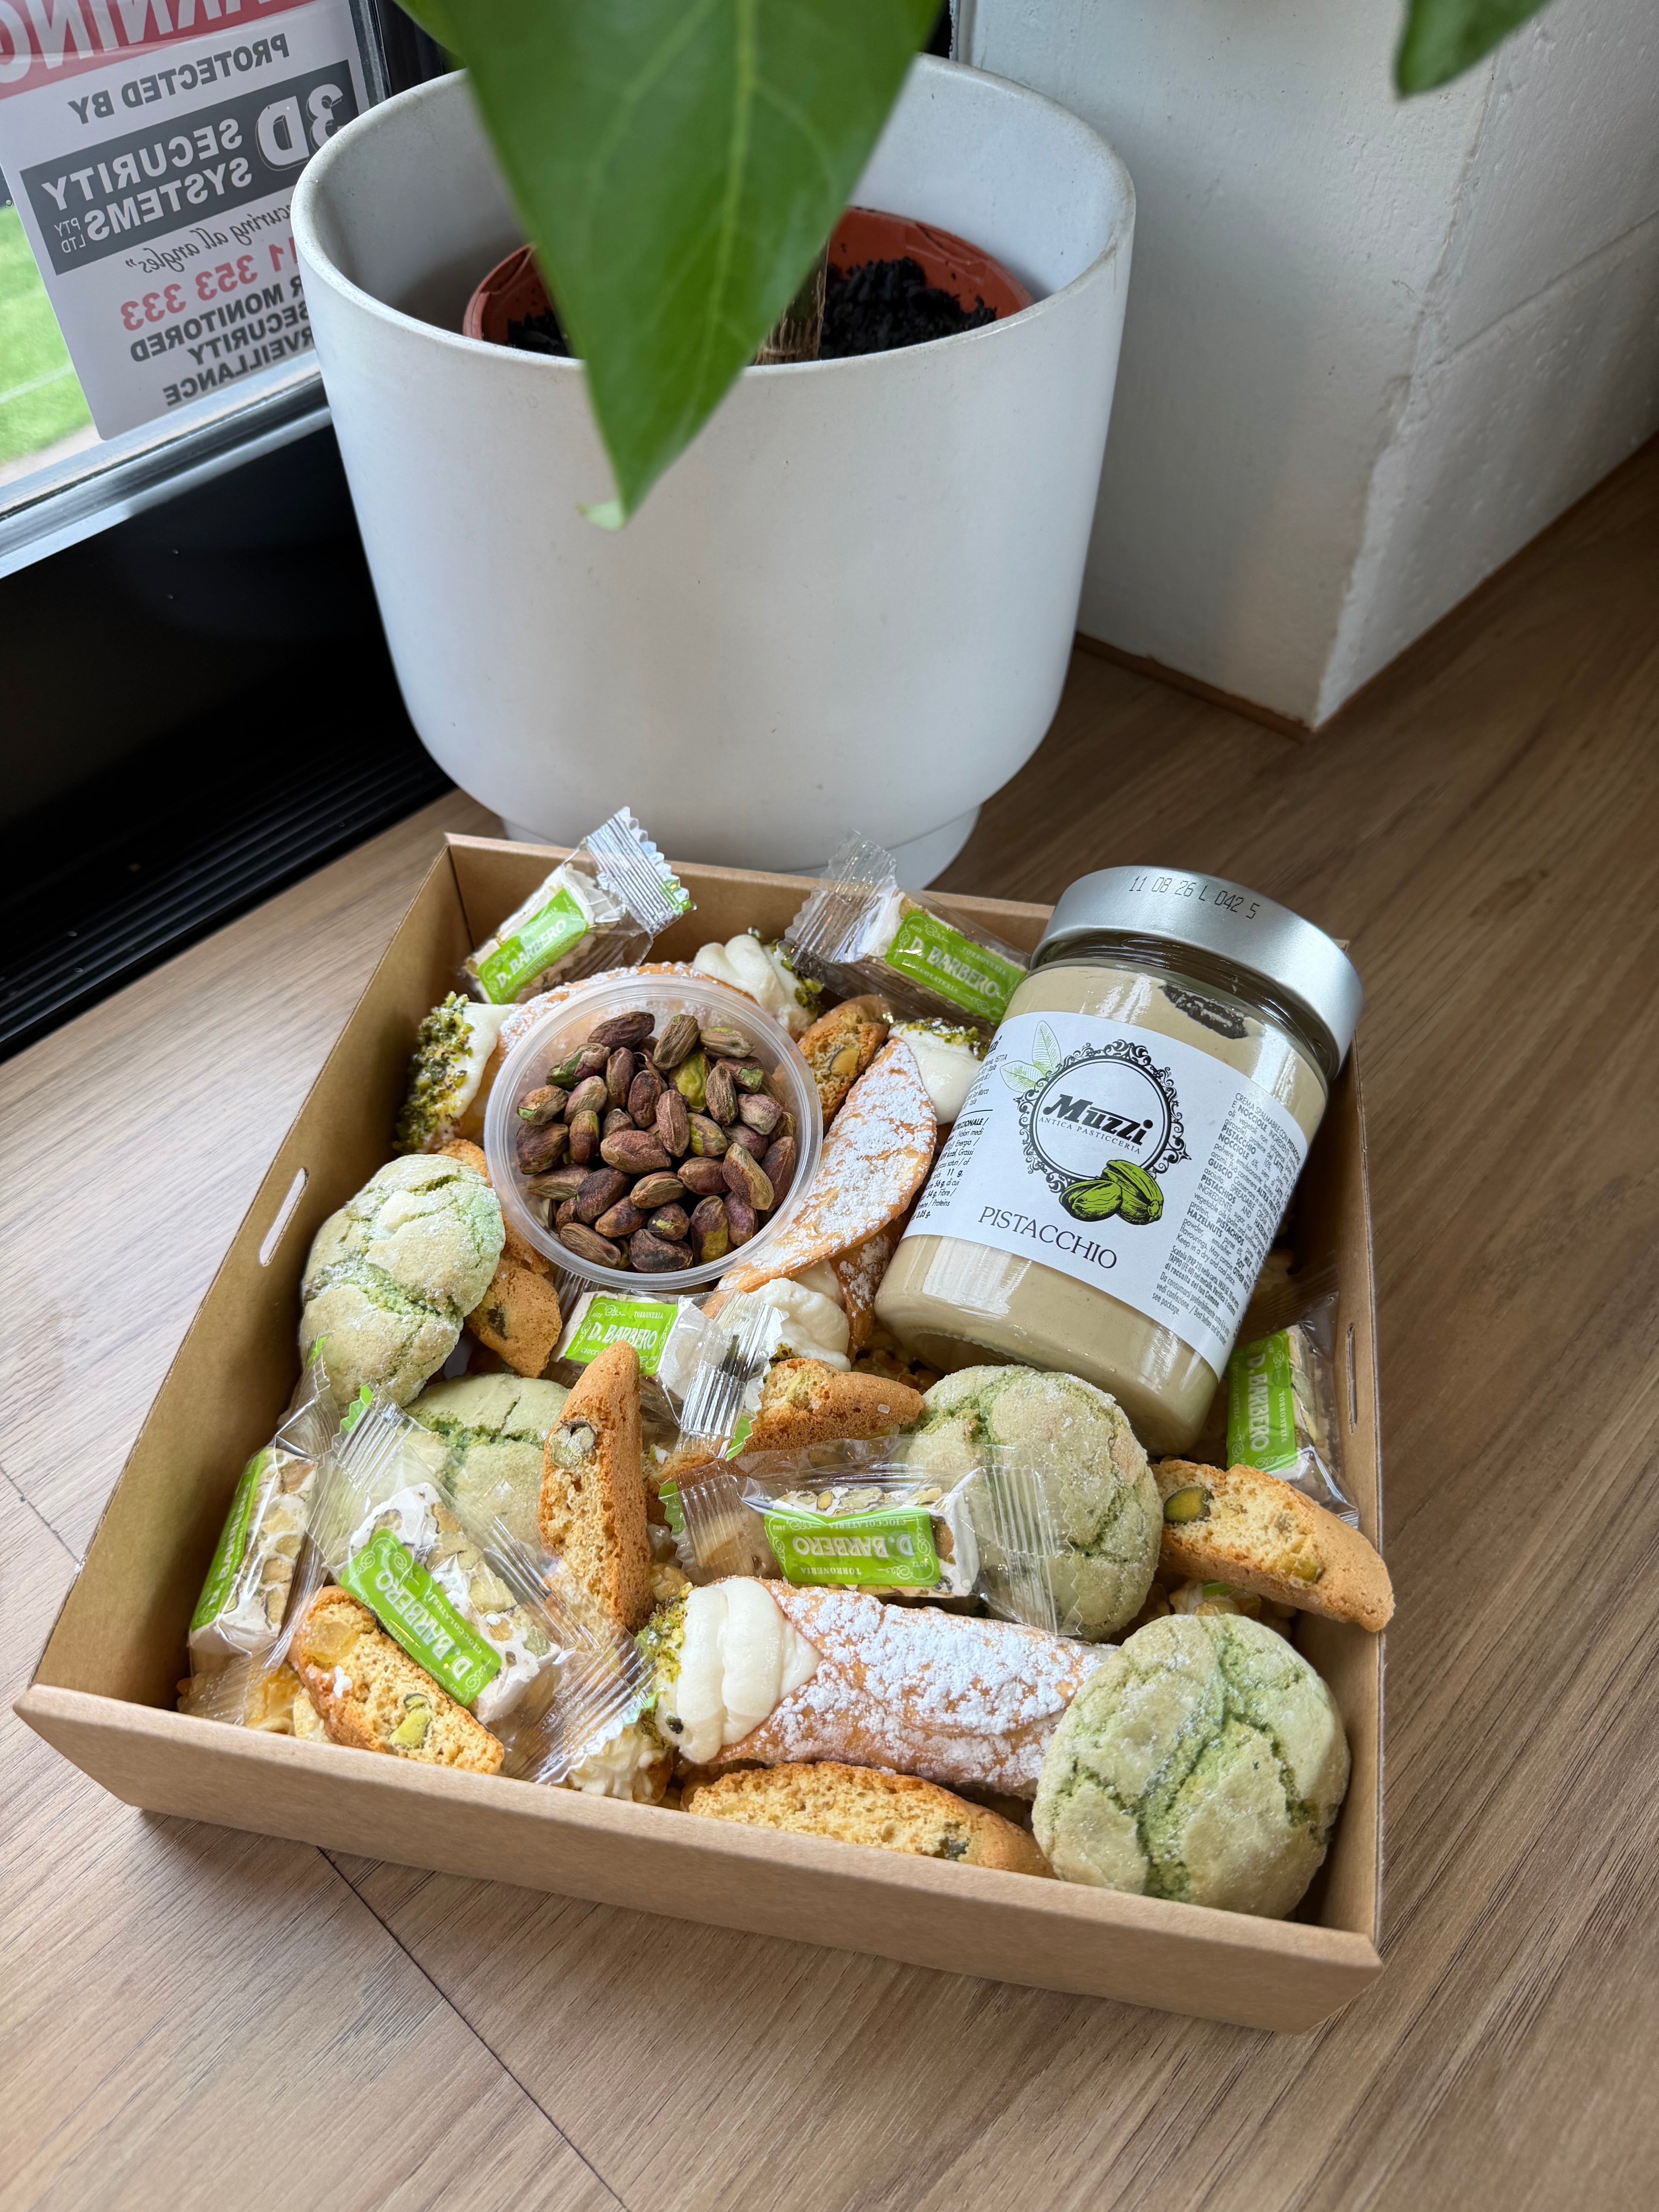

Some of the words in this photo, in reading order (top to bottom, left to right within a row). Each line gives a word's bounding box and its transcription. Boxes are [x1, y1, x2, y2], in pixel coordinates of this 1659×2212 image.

[1128, 876, 1147, 891] 11
[1152, 877, 1172, 893] 08
[1174, 880, 1196, 897] 26
[1198, 885, 1208, 901] L
[1214, 891, 1244, 912] 042
[1246, 903, 1260, 919] 5
[509, 919, 567, 975] BARBERO
[961, 946, 1006, 976] TORRONERIA
[926, 945, 999, 998] BARBERO
[1042, 1094, 1153, 1146] Muzzi
[1231, 1100, 1237, 1108] E
[1234, 1092, 1256, 1111] CREMA
[1254, 1106, 1281, 1133] SPALMABILE
[1278, 1128, 1288, 1143] CON
[970, 1127, 984, 1135] medi
[1038, 1116, 1072, 1130] ANTICA
[1077, 1125, 1140, 1154] PASTICCERIA
[1221, 1124, 1257, 1156] PISTACCHIO
[1228, 1107, 1237, 1118] oli
[1238, 1115, 1258, 1136] vegetali
[1259, 1133, 1268, 1144] non
[1213, 1140, 1236, 1162] polvere,
[1218, 1132, 1250, 1160] NOCCIOLE
[1248, 1134, 1267, 1156] proteine
[938, 1188, 952, 1196] Fibre
[945, 1177, 953, 1185] di
[1210, 1149, 1229, 1166] aromi.
[1228, 1161, 1239, 1173] Può
[1237, 1169, 1258, 1191] contenere
[1256, 1185, 1269, 1204] ALTRA
[1197, 1182, 1233, 1213] INGREDIENTS:
[1233, 1211, 1246, 1228] sugar,
[1200, 1173, 1237, 1204] PISTACHIOS
[1240, 1204, 1252, 1219] AND
[1229, 1183, 1255, 1211] SPREADABLE
[1186, 1207, 1223, 1238] HAZELNUTS
[1223, 1236, 1235, 1252] puree
[1189, 1199, 1211, 1219] protein,
[1215, 1216, 1244, 1247] PISTACHIOS
[1192, 1190, 1220, 1215] vegetable
[1218, 1206, 1228, 1219] oils
[1225, 1213, 1239, 1232] (palm
[1237, 1223, 1246, 1237] and
[978, 1206, 1117, 1269] PISTACCHIO
[1175, 1233, 1191, 1250] Keep
[1190, 1242, 1197, 1252] in
[1199, 1249, 1211, 1264] dry
[1209, 1255, 1219, 1269] and
[1218, 1262, 1228, 1276] cool
[1178, 1223, 1211, 1252] flavourings.
[1208, 1244, 1221, 1261] May
[1219, 1253, 1234, 1271] contain
[1182, 1215, 1206, 1237] powder,
[1235, 1257, 1245, 1272] SOY
[1164, 1261, 1171, 1271] di
[1170, 1265, 1192, 1285] raccolta
[1190, 1279, 1199, 1290] del
[1197, 1285, 1206, 1295] tuo
[1167, 1253, 1183, 1267] TAPPO
[1180, 1261, 1189, 1273] (FE
[1186, 1265, 1195, 1277] 40)
[1171, 1245, 1188, 1261] Scatola
[1185, 1254, 1197, 1268] (PAP
[1194, 1261, 1202, 1272] 21)
[1200, 1265, 1211, 1278] nella
[1155, 1280, 1168, 1294] vedi
[1166, 1287, 1192, 1310] confezione.
[1188, 1303, 1195, 1316] /
[1193, 1307, 1203, 1320] Best
[1159, 1271, 1168, 1283] Da
[1166, 1276, 1192, 1298] consumarsi
[634, 1310, 664, 1319] TORRONERIA
[1151, 1292, 1161, 1302] see
[1159, 1295, 1182, 1317] package.
[587, 1322, 602, 1341] D.
[601, 1324, 658, 1350] BARBERO
[1247, 1371, 1269, 1452] BARBERO
[828, 1518, 907, 1530] CIOCCOLATERIA
[792, 1535, 889, 1558] BARBERO
[888, 1534, 915, 1557] D.
[800, 1567, 862, 1575] TORRONERIA
[375, 1570, 455, 1661] BARBERO
[451, 1647, 474, 1681] D.
